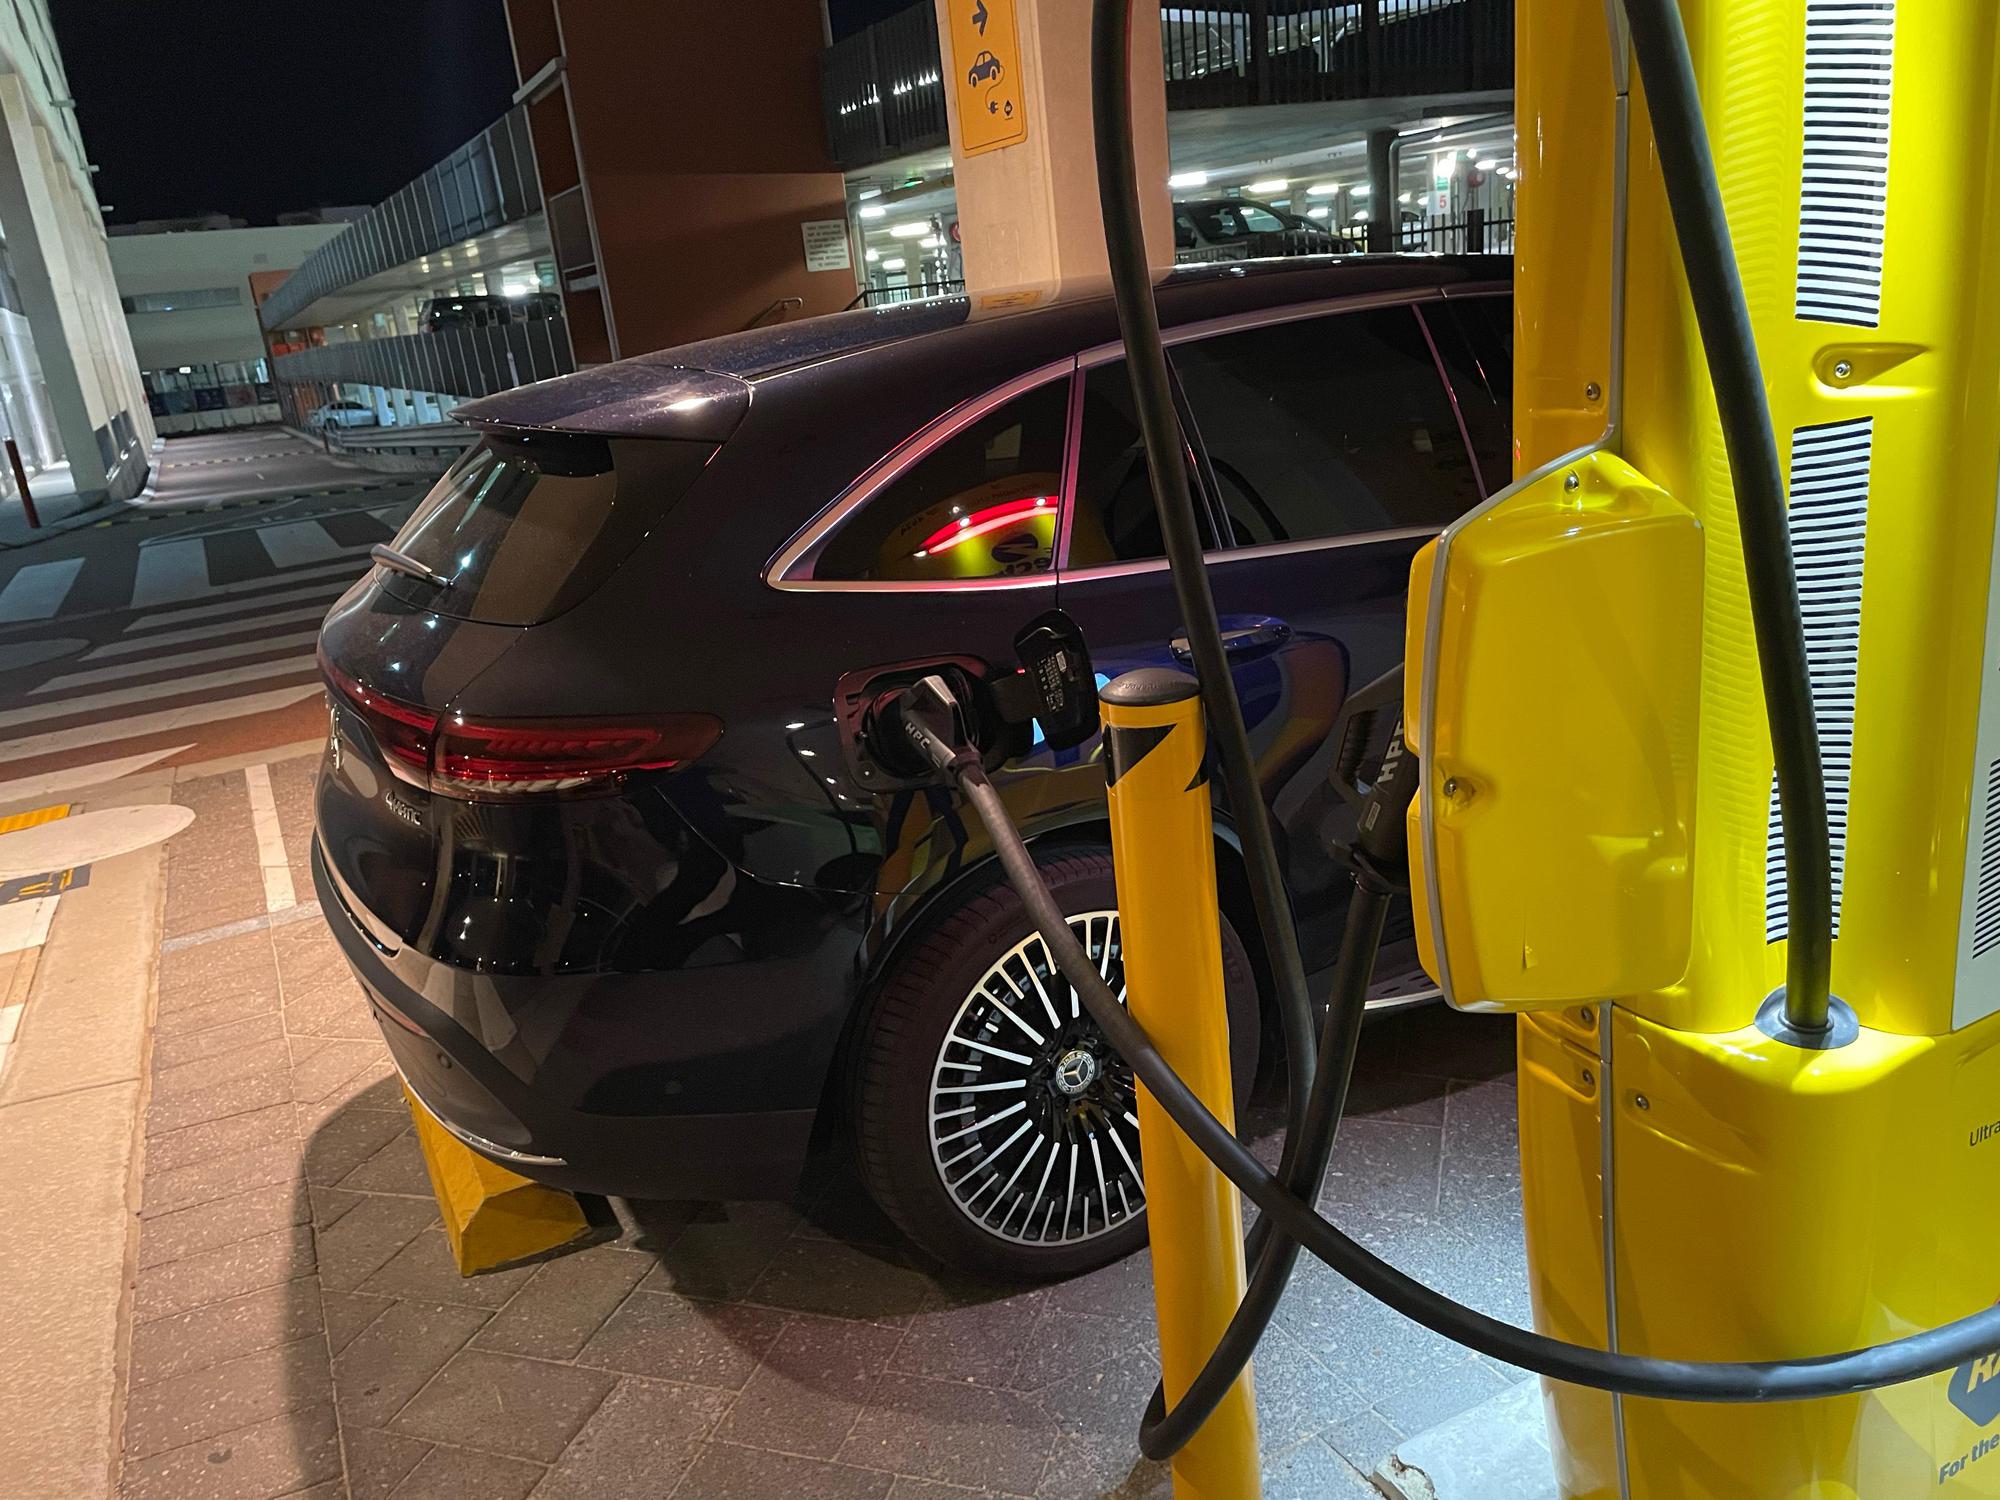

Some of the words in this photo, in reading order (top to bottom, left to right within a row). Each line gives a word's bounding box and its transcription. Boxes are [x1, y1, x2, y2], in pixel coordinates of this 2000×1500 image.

[1439, 195, 1447, 209] 5
[905, 722, 930, 749] HPC
[1969, 1120, 2000, 1147] Ultra
[1939, 1453, 1969, 1486] For
[1971, 1433, 2000, 1462] the
